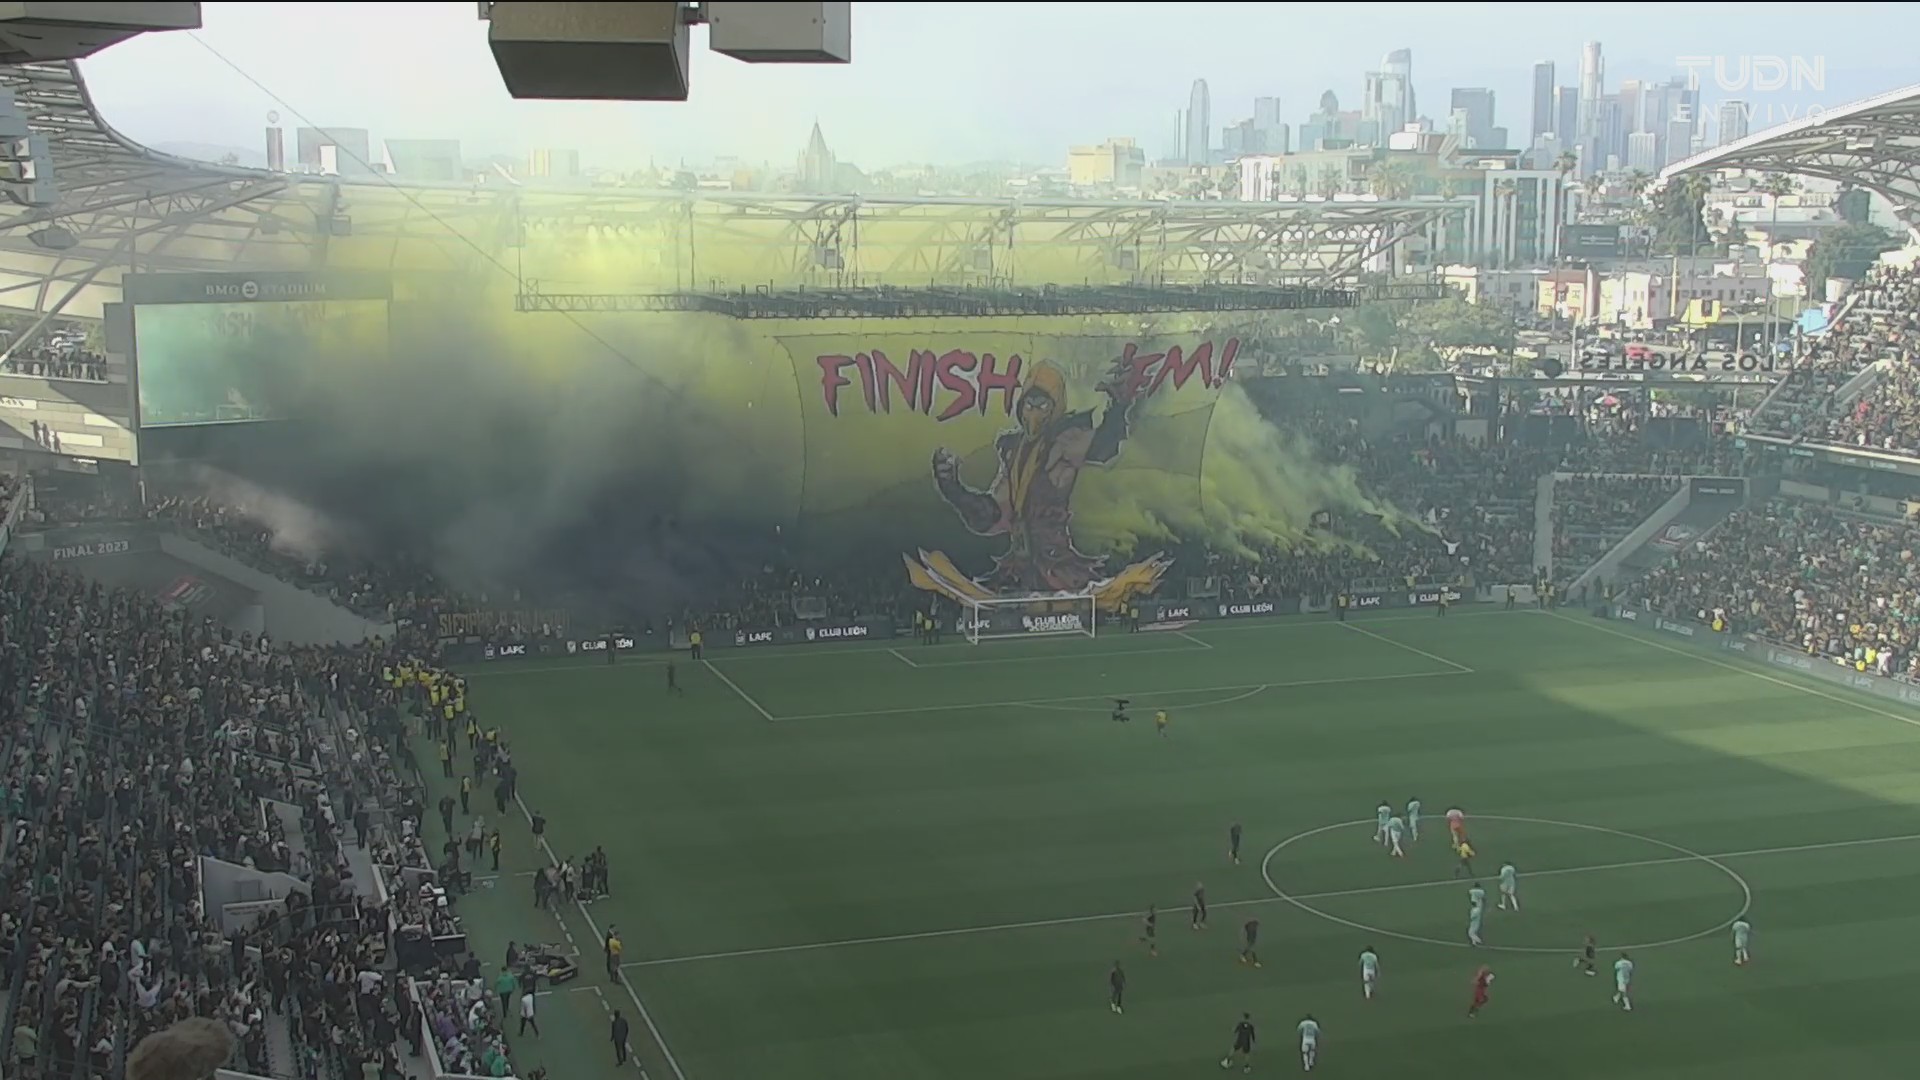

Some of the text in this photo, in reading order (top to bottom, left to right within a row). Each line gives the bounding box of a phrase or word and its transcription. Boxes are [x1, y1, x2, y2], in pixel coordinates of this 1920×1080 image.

[206, 282, 327, 296] BMO STADIUM
[817, 348, 1022, 423] FINISH
[53, 540, 129, 560] FINAL 2023
[1168, 607, 1189, 617] LAFC
[749, 631, 773, 642] LAFC
[818, 627, 842, 638] CLUB
[500, 645, 525, 655] LAFC
